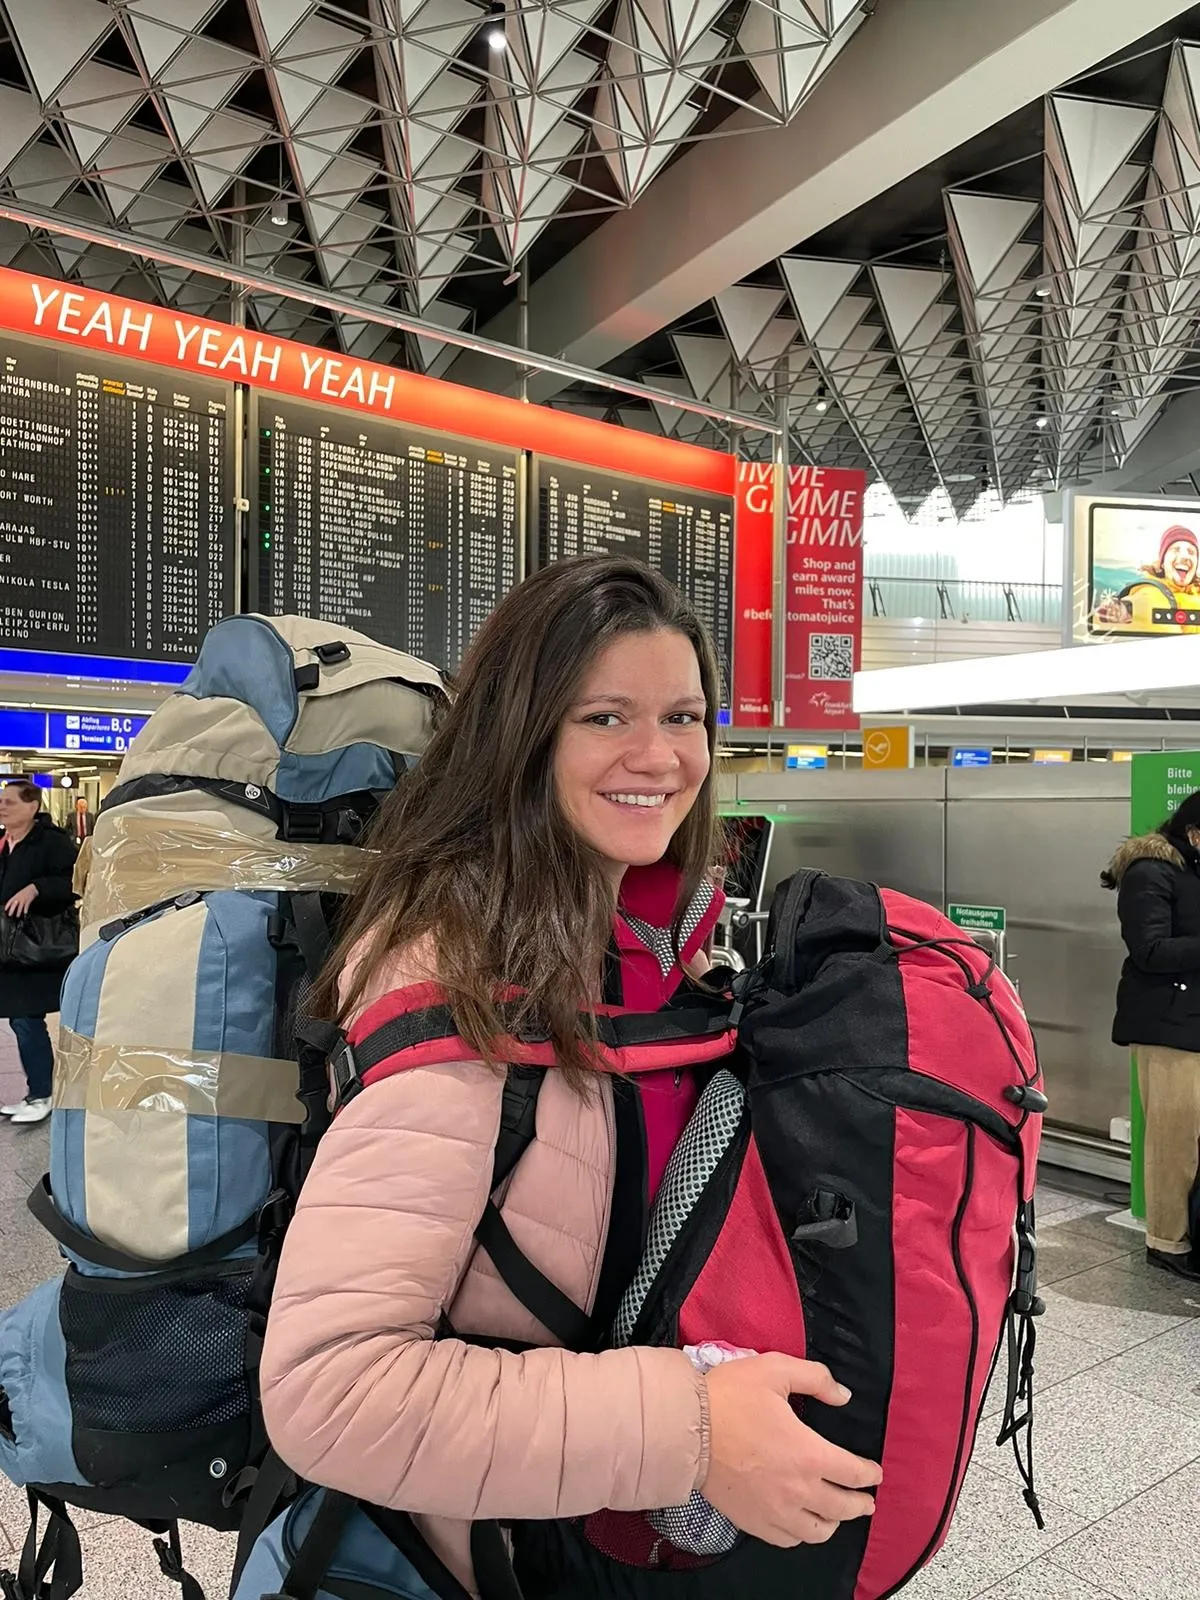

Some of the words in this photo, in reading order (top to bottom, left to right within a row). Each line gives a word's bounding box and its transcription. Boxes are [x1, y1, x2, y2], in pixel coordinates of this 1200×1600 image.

[31, 283, 153, 351] YEAH
[174, 320, 282, 382] YEAH
[300, 351, 396, 410] YEAH
[12, 471, 35, 483] HARE
[24, 494, 53, 506] WORTH
[29, 537, 70, 550] HBF-STU
[803, 557, 831, 572] Shop
[834, 560, 856, 571] and
[0, 576, 35, 588] NIKOLA
[42, 580, 70, 592] TESLA
[792, 573, 818, 583] earn
[821, 573, 856, 584] award
[795, 584, 825, 596] miles
[827, 587, 855, 598] now.
[29, 610, 64, 621] GURION
[81, 735, 104, 743] Terminal
[1167, 768, 1192, 778] Bitte
[956, 908, 998, 920] Notausgang
[960, 917, 994, 927] freihalten
